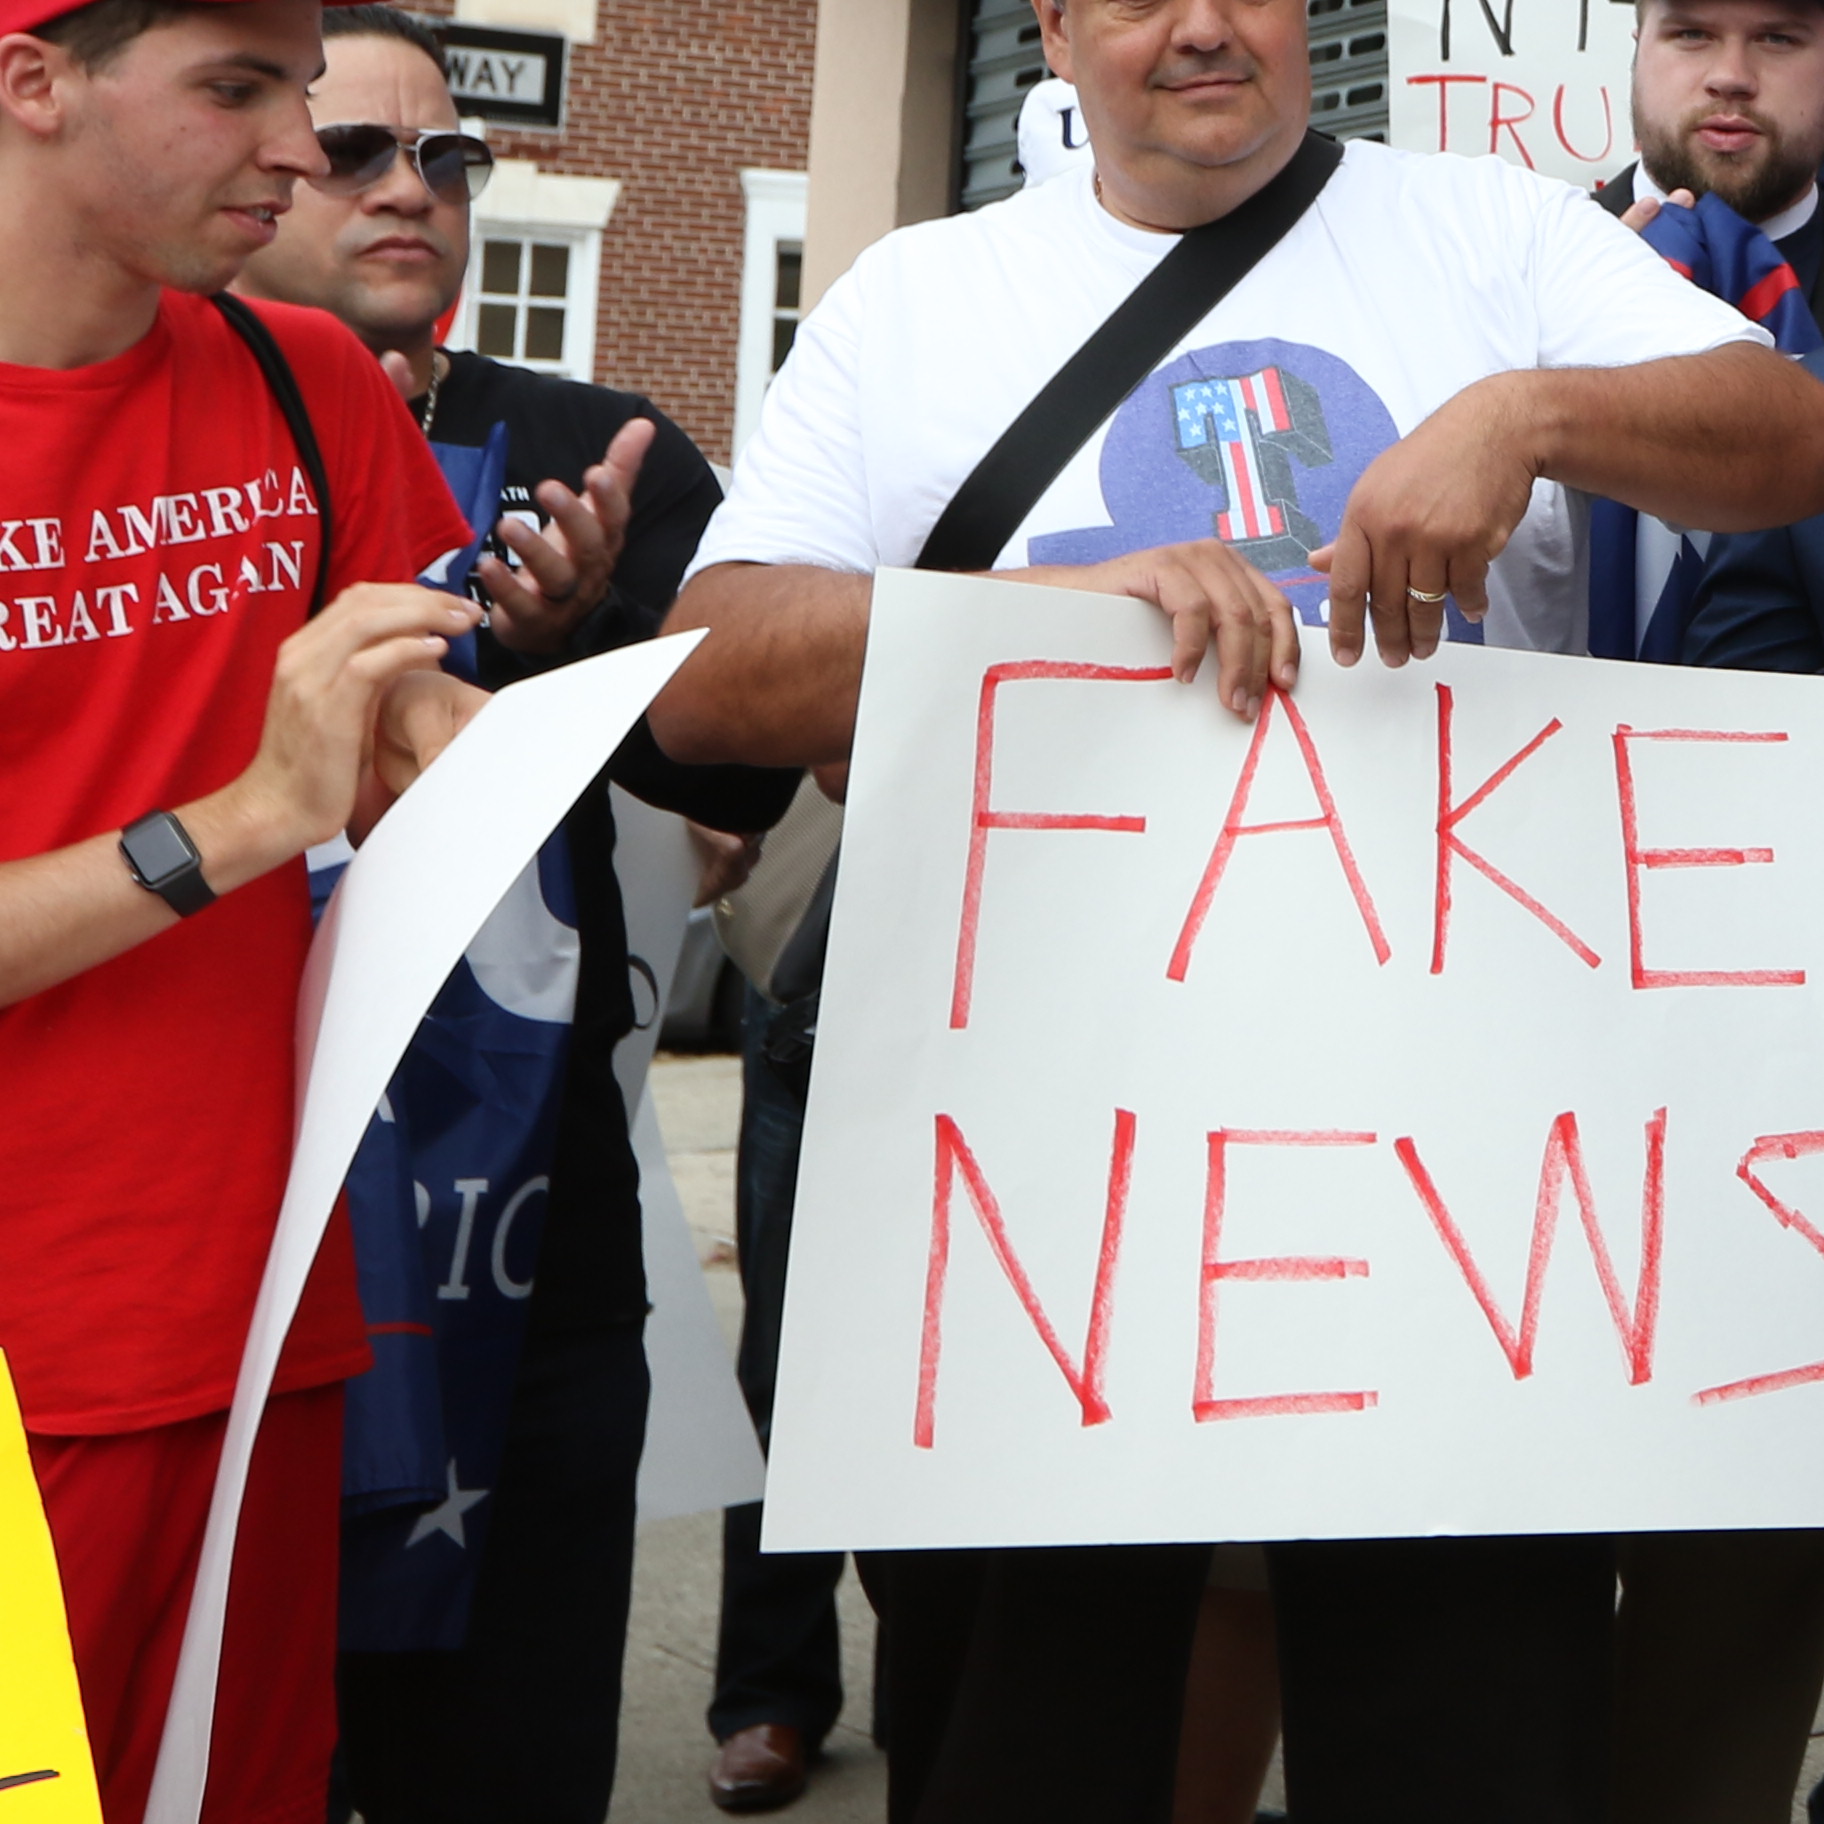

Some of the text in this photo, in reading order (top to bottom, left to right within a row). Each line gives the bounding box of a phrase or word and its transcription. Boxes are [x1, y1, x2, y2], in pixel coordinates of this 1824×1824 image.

[1405, 74, 1640, 169] TRU
[153, 541, 304, 624] AGAN
[950, 661, 1807, 1030] FAKE
